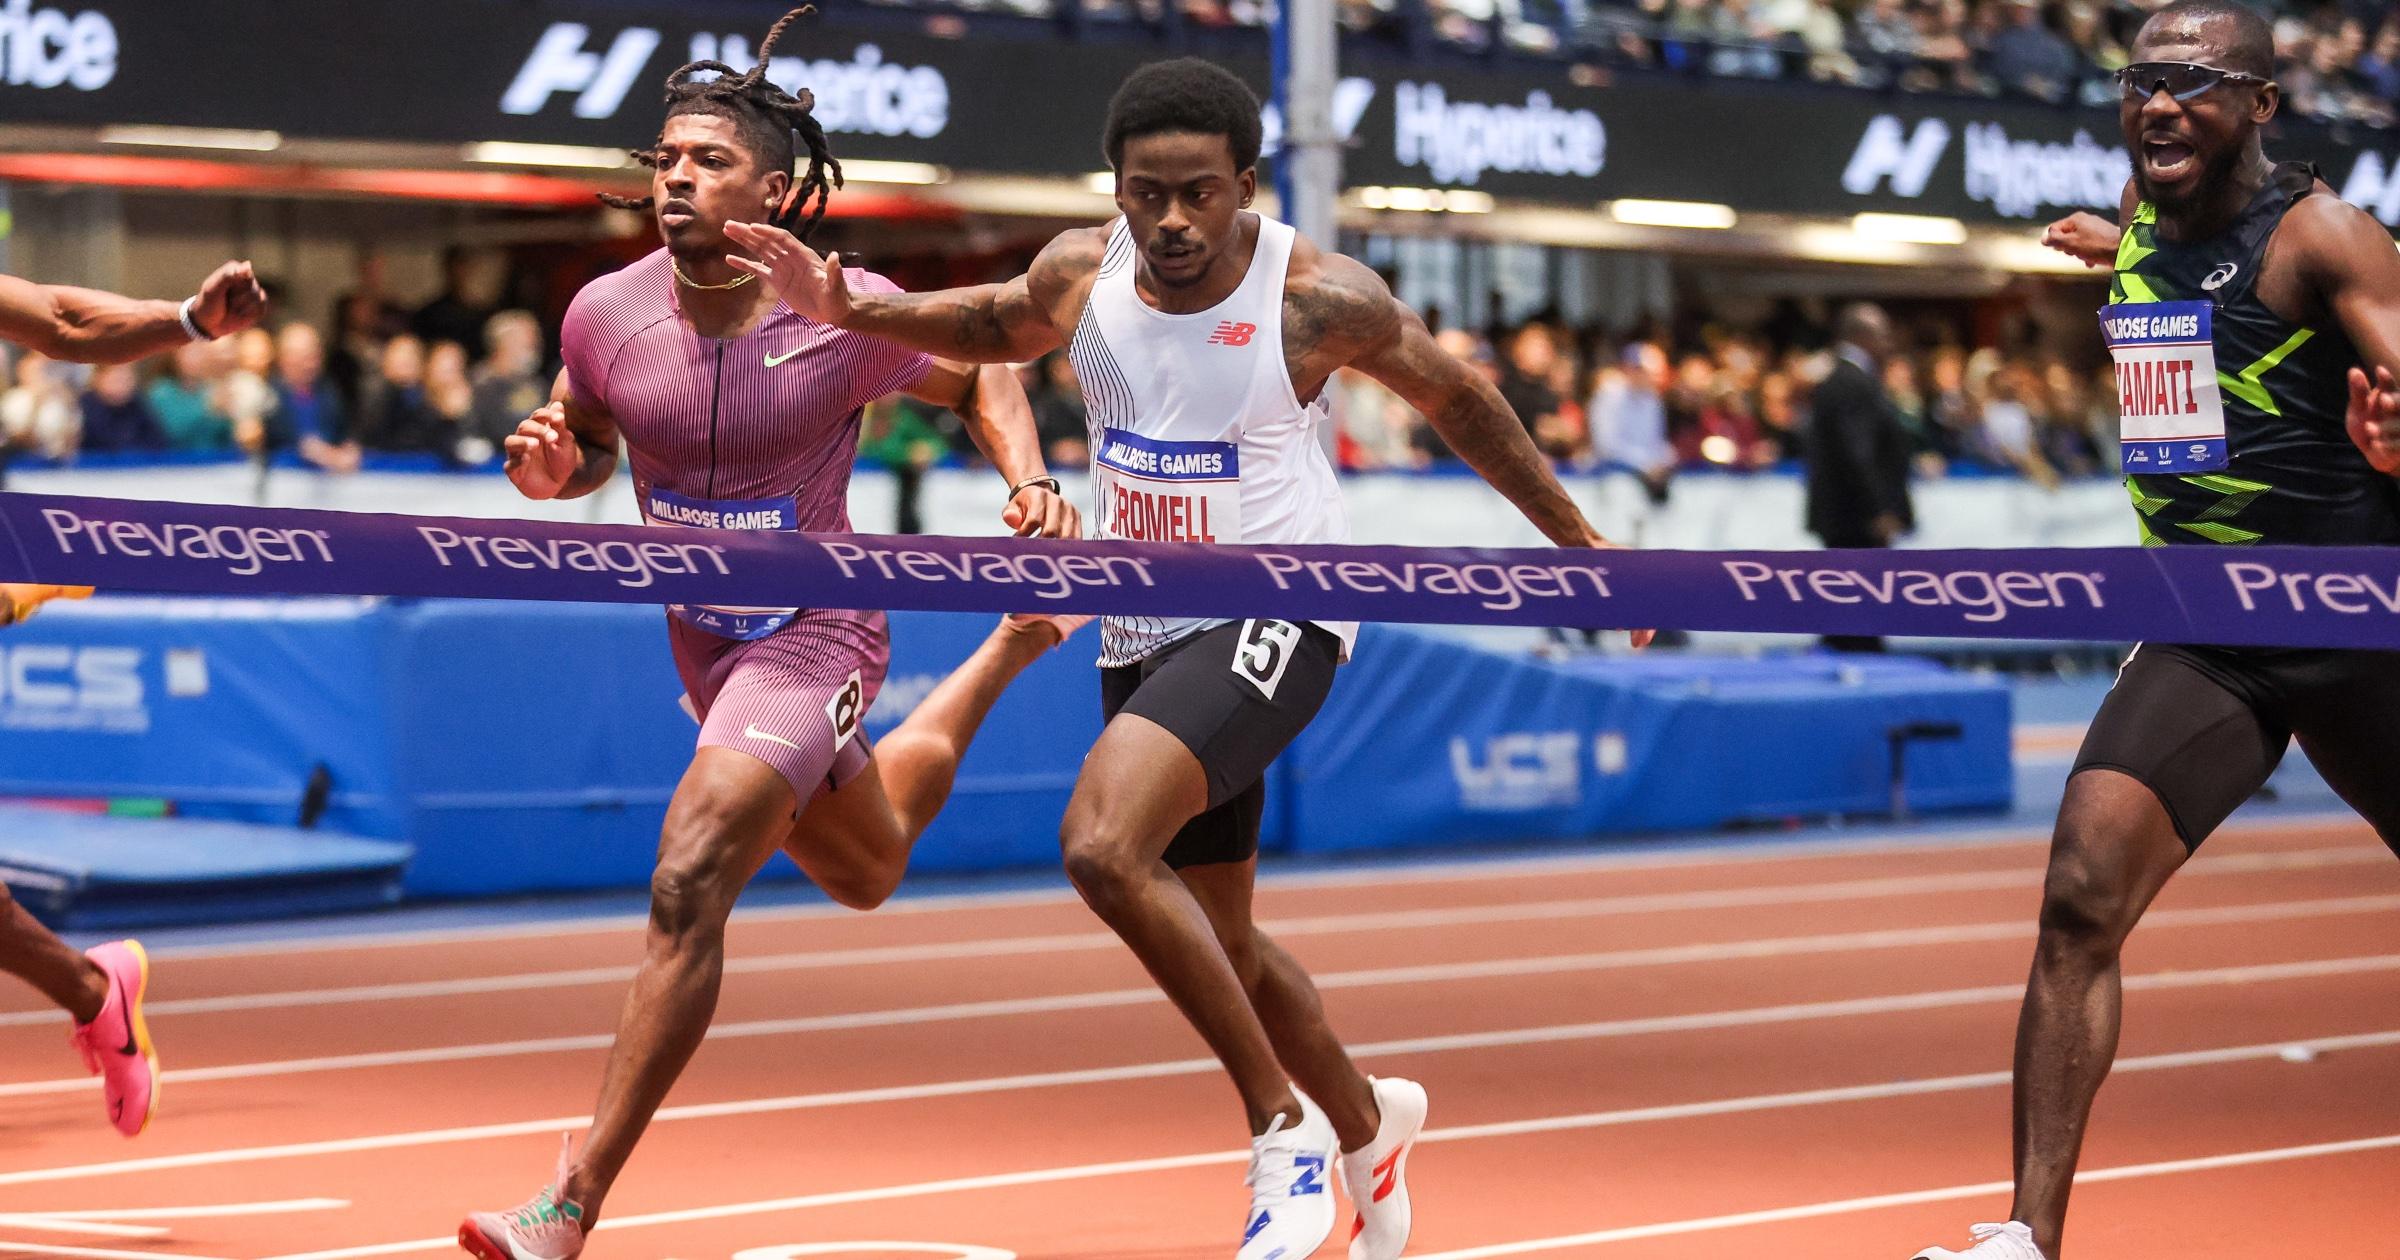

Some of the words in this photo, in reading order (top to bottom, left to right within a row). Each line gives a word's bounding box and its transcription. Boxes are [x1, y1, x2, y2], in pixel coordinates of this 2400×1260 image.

[689, 31, 948, 138] Herice
[2150, 315, 2198, 338] GAMES
[1105, 441, 1158, 473] MILLROSE
[1160, 453, 1223, 475] GAMES
[652, 498, 720, 529] MILLROSE
[723, 509, 782, 530] GAMES
[0, 645, 144, 709] CS
[1242, 619, 1290, 683] 5
[835, 680, 860, 737] 8
